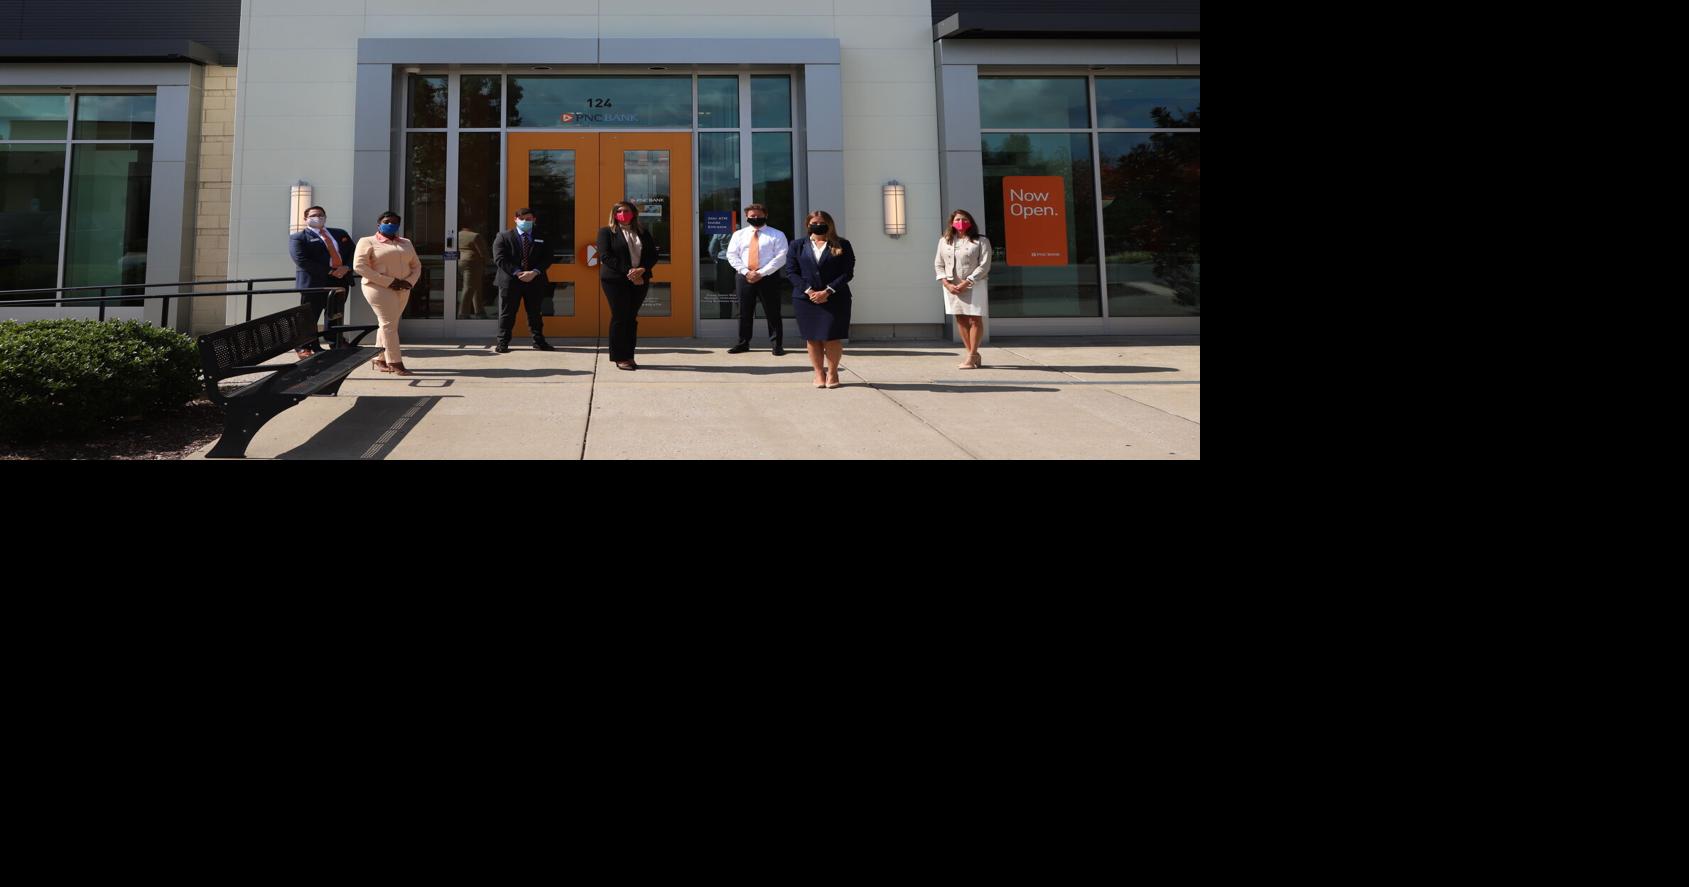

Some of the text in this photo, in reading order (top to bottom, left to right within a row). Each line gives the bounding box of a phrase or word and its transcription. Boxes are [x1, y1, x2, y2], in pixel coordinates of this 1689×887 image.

[586, 98, 612, 108] 124
[575, 113, 638, 122] PNC BANK
[1010, 188, 1049, 201] Now
[1010, 203, 1058, 220] Open.
